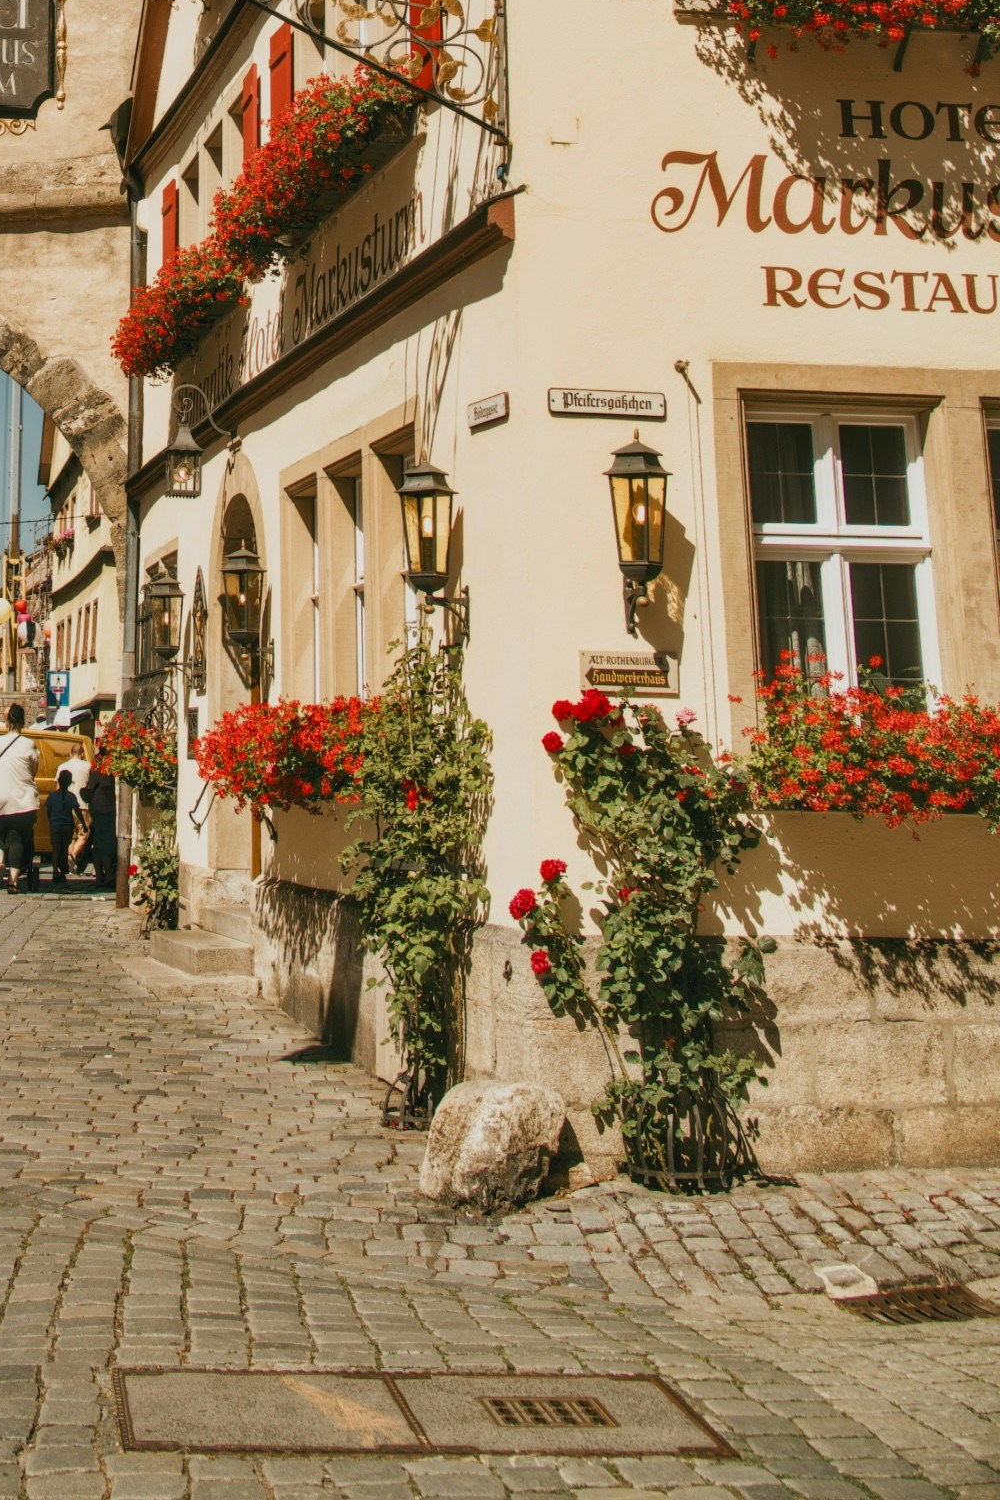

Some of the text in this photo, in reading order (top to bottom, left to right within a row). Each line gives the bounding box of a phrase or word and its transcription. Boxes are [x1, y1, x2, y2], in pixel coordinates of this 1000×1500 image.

[240, 292, 286, 382] Hotel
[292, 191, 427, 346] Markusturm
[761, 266, 1000, 315] RESTAU
[589, 655, 665, 667] ALT-ROTHENBURGER
